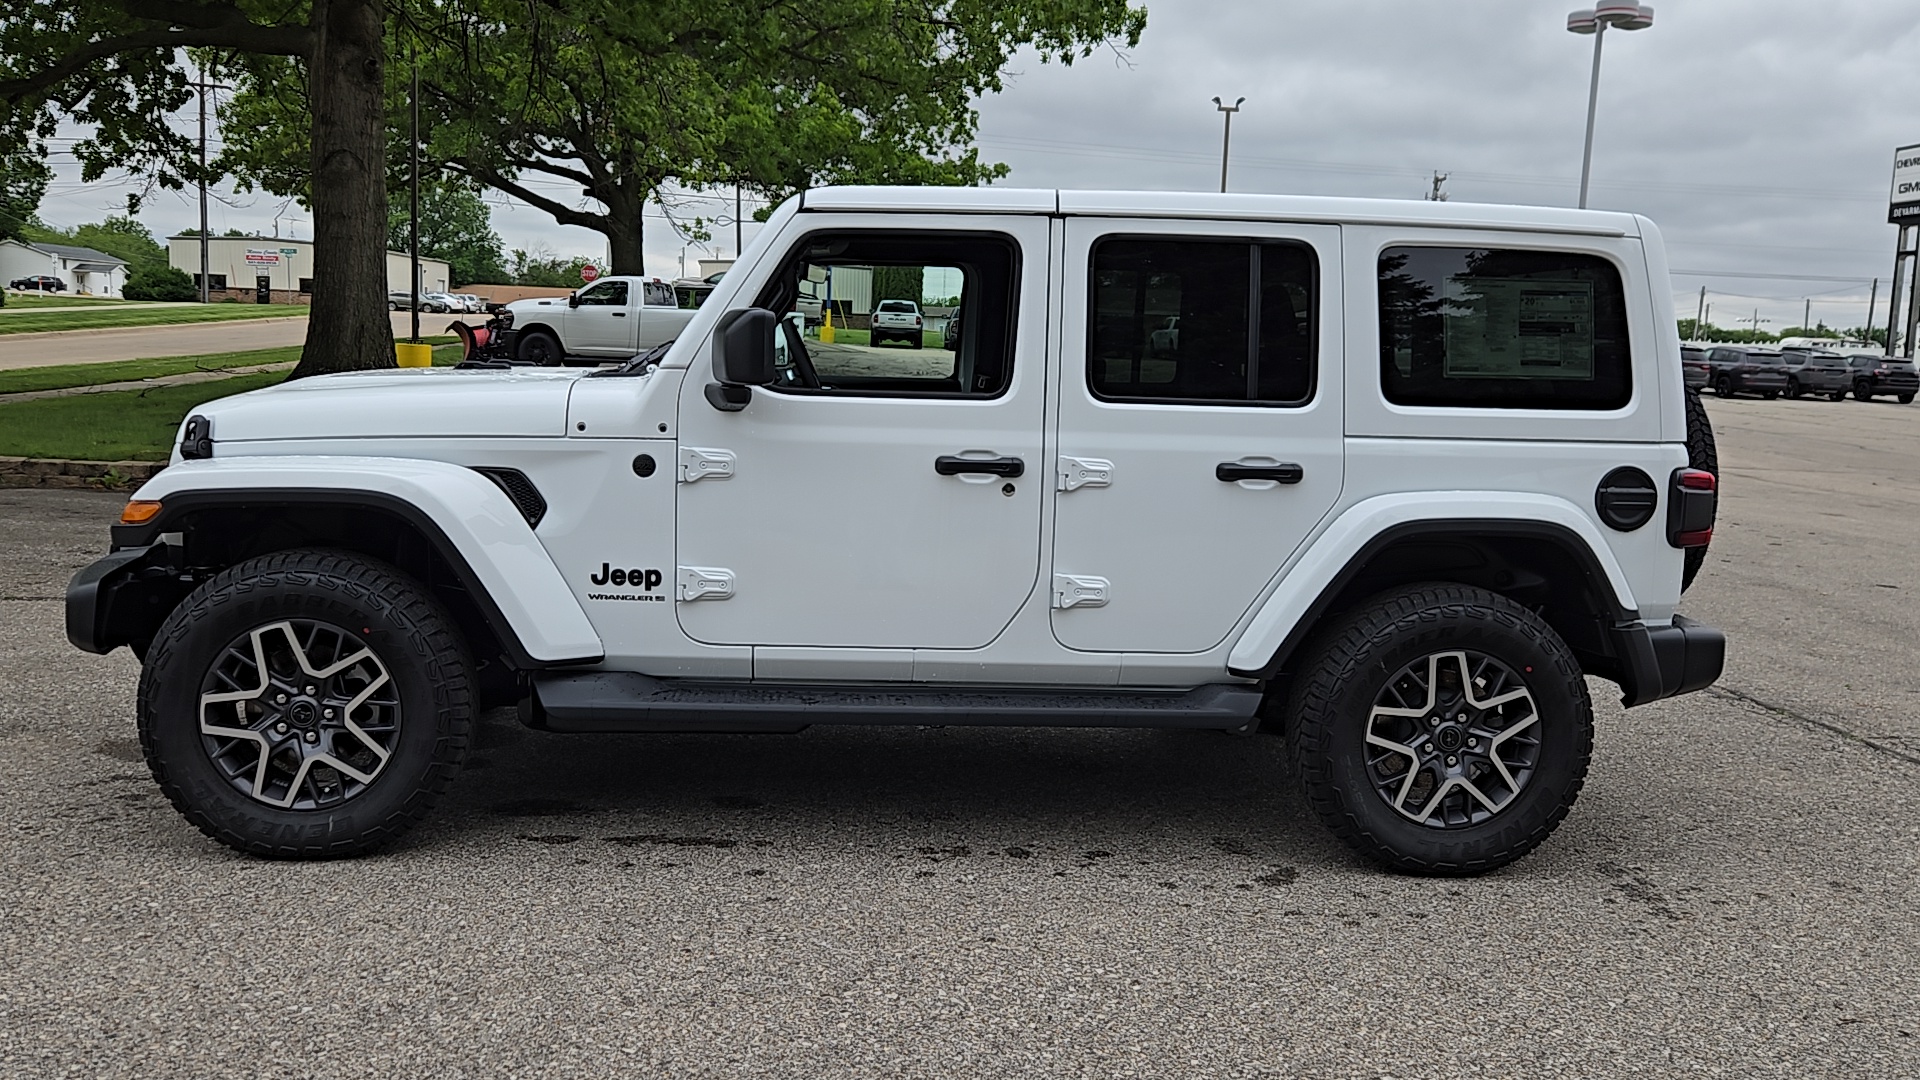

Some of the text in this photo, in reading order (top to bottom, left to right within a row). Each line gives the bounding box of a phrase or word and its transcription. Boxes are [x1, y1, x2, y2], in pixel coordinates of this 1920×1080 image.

[1898, 181, 1920, 194] GM
[582, 269, 597, 277] STOP
[590, 562, 662, 591] Jeep
[588, 593, 653, 601] WRANGLER
